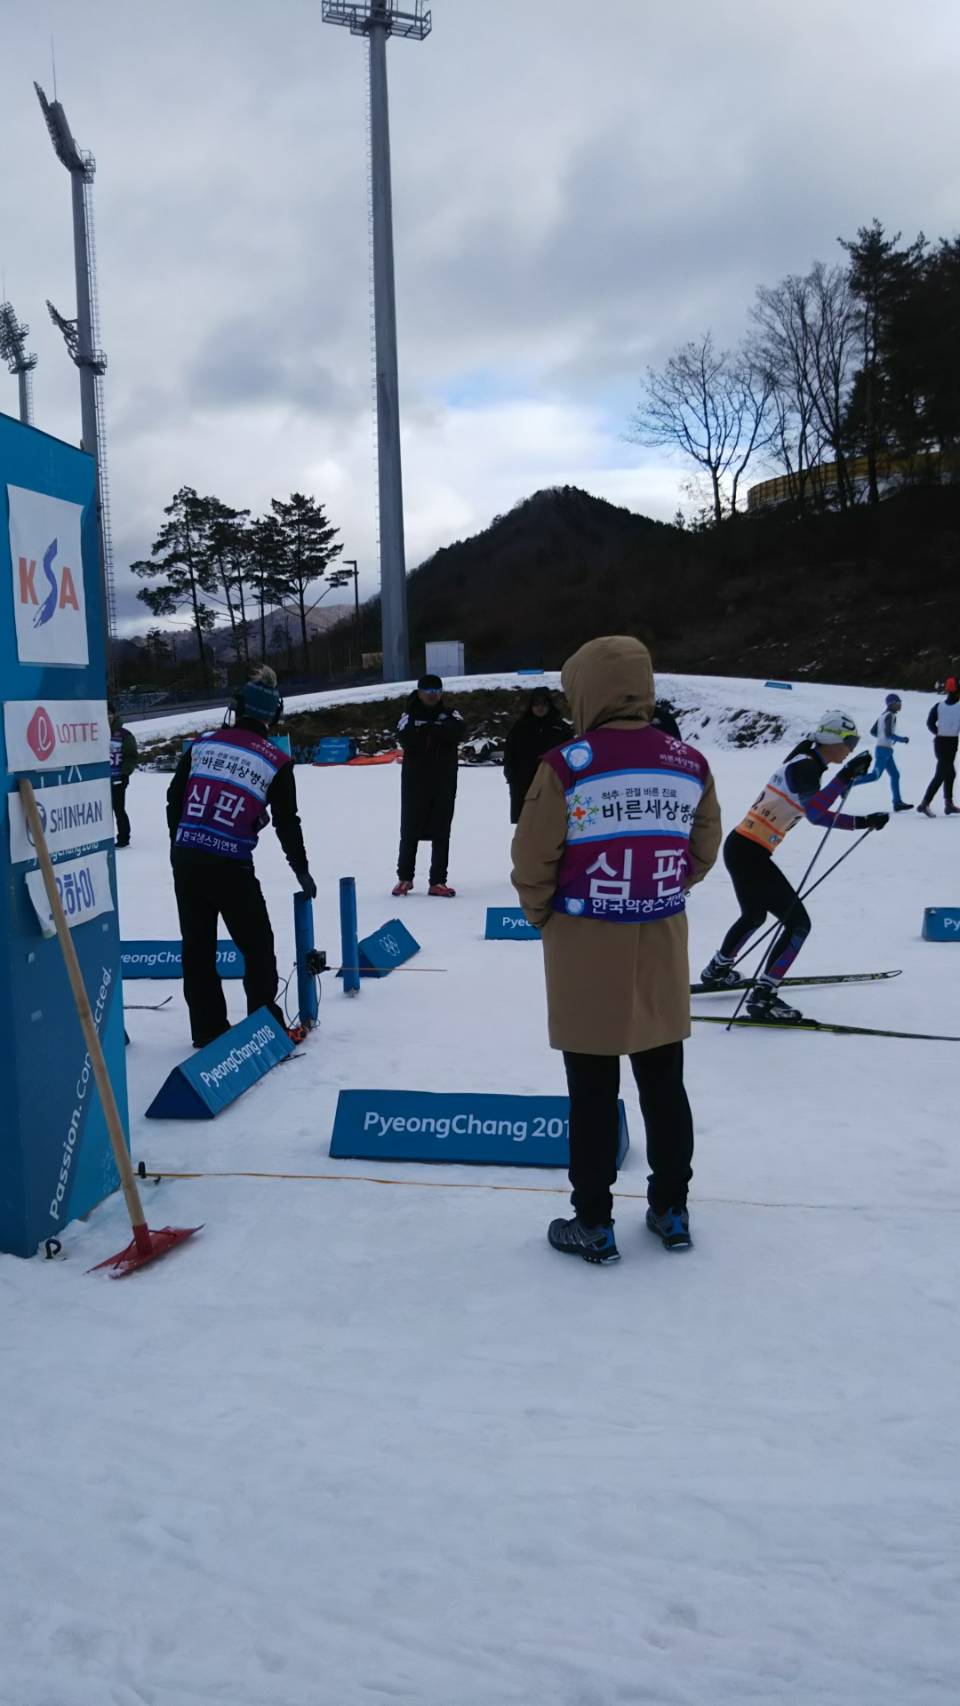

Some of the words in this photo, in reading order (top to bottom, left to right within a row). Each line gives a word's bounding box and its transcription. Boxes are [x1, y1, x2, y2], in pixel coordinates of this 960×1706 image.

[19, 538, 79, 628] KSA
[57, 722, 98, 743] LOTTE
[50, 799, 102, 833] SHINHAN
[187, 784, 245, 827] 심판
[49, 1104, 83, 1221] Passion.
[76, 966, 112, 1101] Concted.
[363, 1111, 527, 1142] PyeongChang
[532, 1117, 569, 1139] 201
